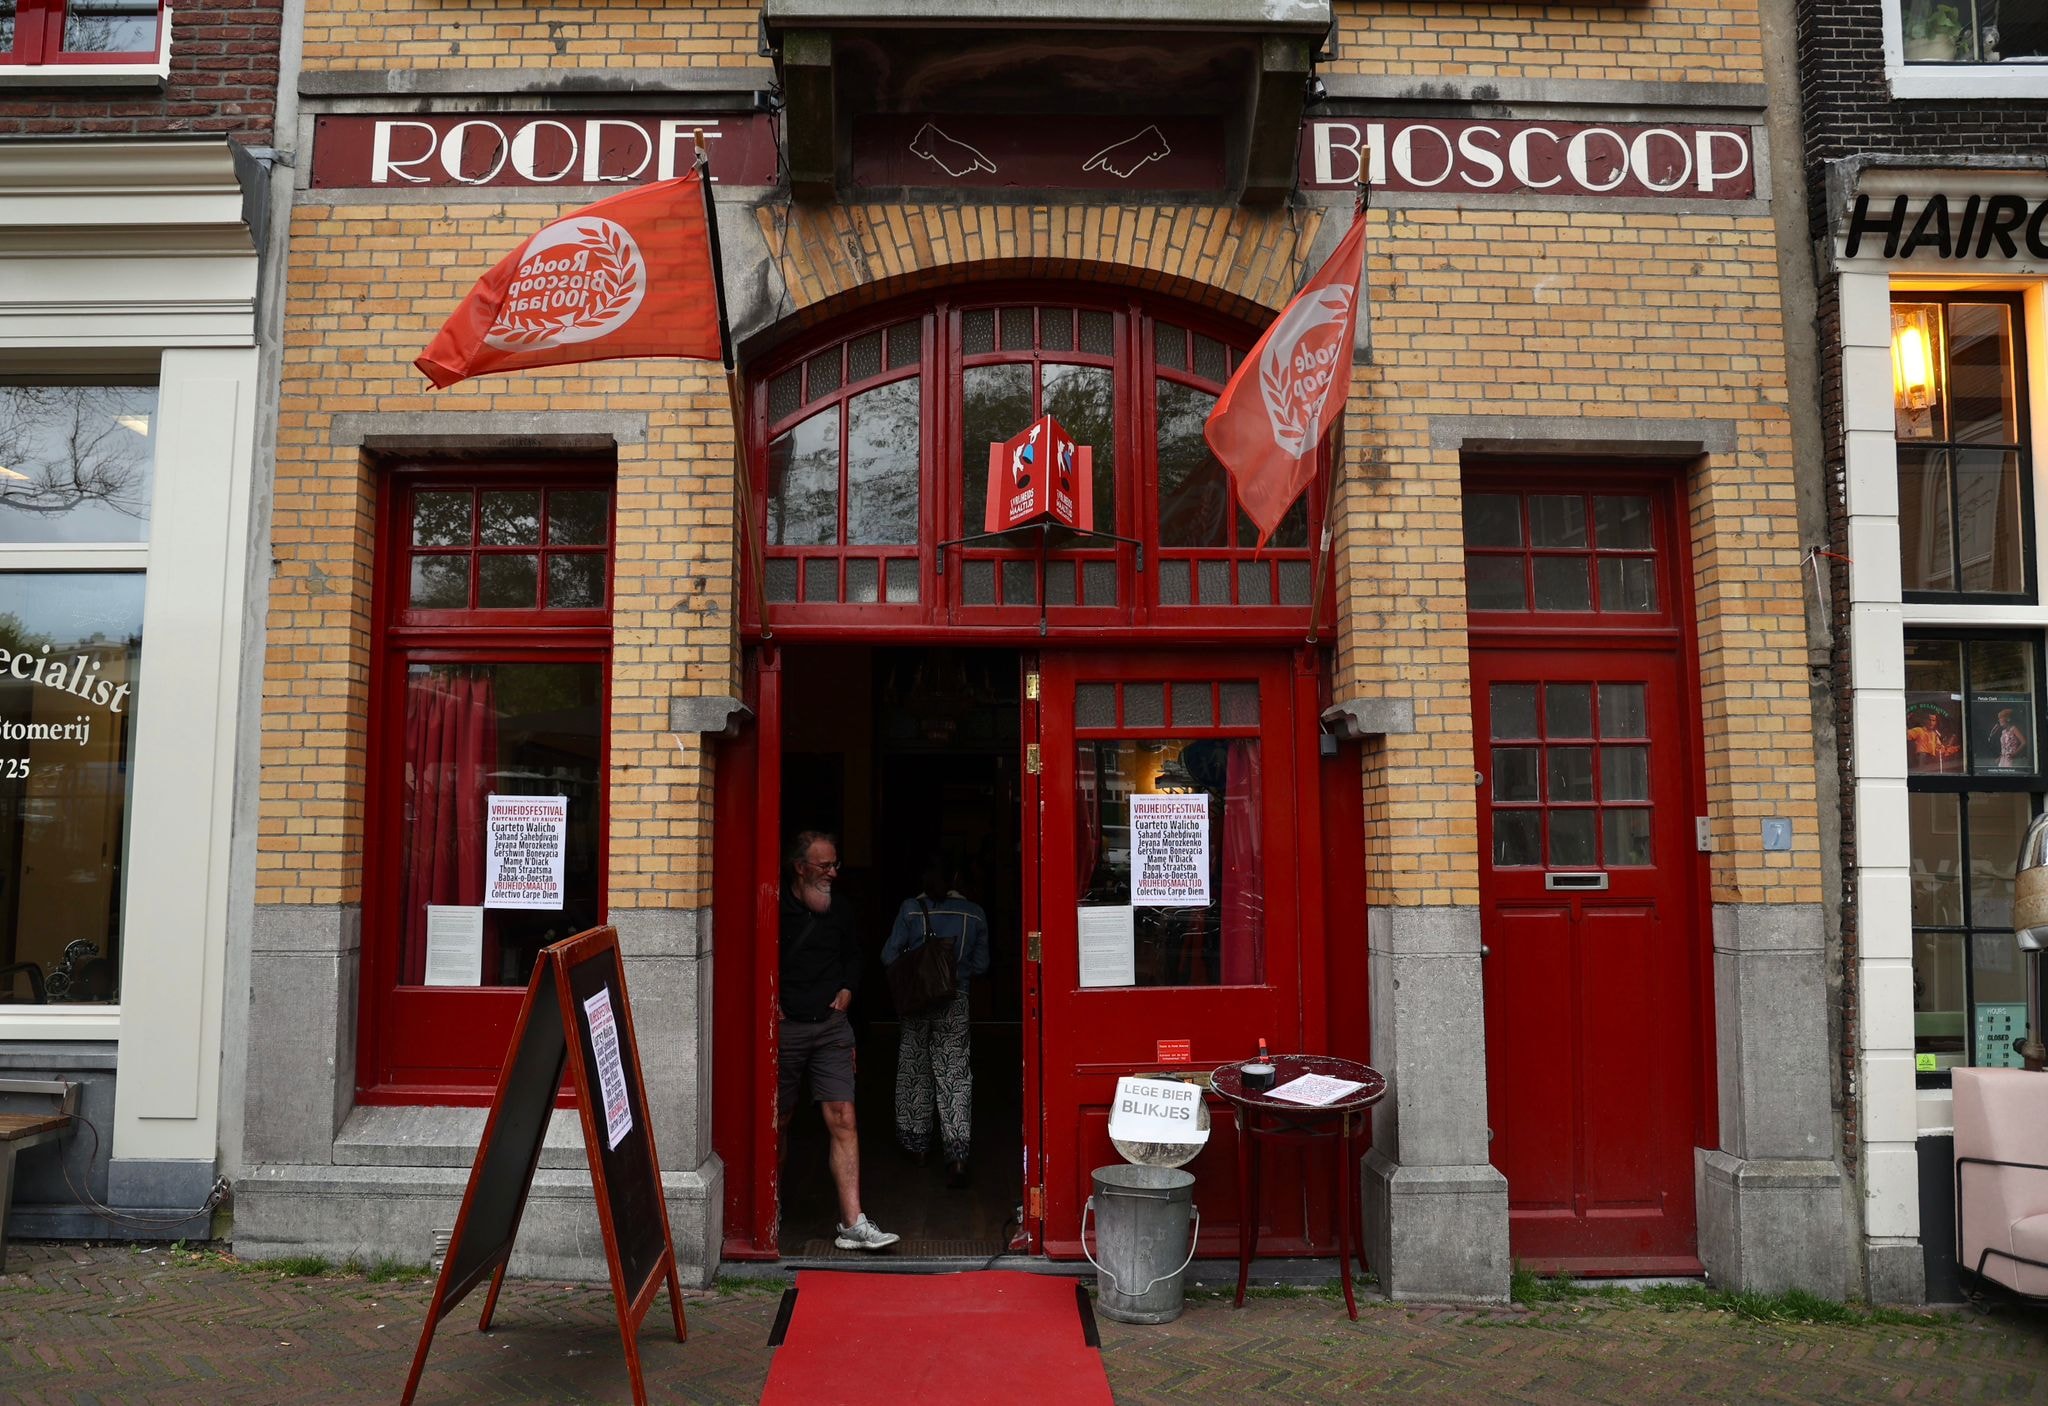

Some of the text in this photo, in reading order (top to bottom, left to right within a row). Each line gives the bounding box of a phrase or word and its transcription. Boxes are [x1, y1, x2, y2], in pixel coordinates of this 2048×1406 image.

[371, 120, 722, 185] ROODE
[1313, 123, 1749, 192] BIOSCOOP
[0, 715, 91, 746] tomerij
[491, 805, 564, 816] VRIJHEIDSFESTIVAL
[1134, 803, 1206, 814] VRIJHEIDSFESTIVAL
[491, 822, 556, 832] Cuarteto Walicho
[1135, 820, 1200, 830] Cuarteto Walicho
[495, 832, 519, 841] Sahand
[1138, 830, 1162, 839] Sahand
[1769, 822, 1785, 847] 7
[495, 841, 559, 850] Jeyana Morozkenko
[1139, 838, 1202, 848] Jeyana Morozkenko
[493, 849, 559, 858] Gershwin Bonevacia
[1137, 846, 1203, 855] Gershwin Bonevacia
[503, 857, 523, 866] Mame
[1147, 855, 1167, 863] Mame
[500, 865, 552, 874] Thom Straatsma
[1144, 862, 1197, 871] Thom Straatsma
[494, 881, 557, 891] VRIJHEIDSMAALTIJD
[1139, 879, 1202, 888] VRIJHEIDSMAALTIJD
[491, 889, 559, 900] Colectivo Carpe Diem
[1136, 887, 1205, 897] Colectivo Carpe Diem
[1987, 1007, 2007, 1015] HOURS
[1124, 1084, 1192, 1101] LEGE BIER
[1122, 1100, 1190, 1120] BLIKJES
